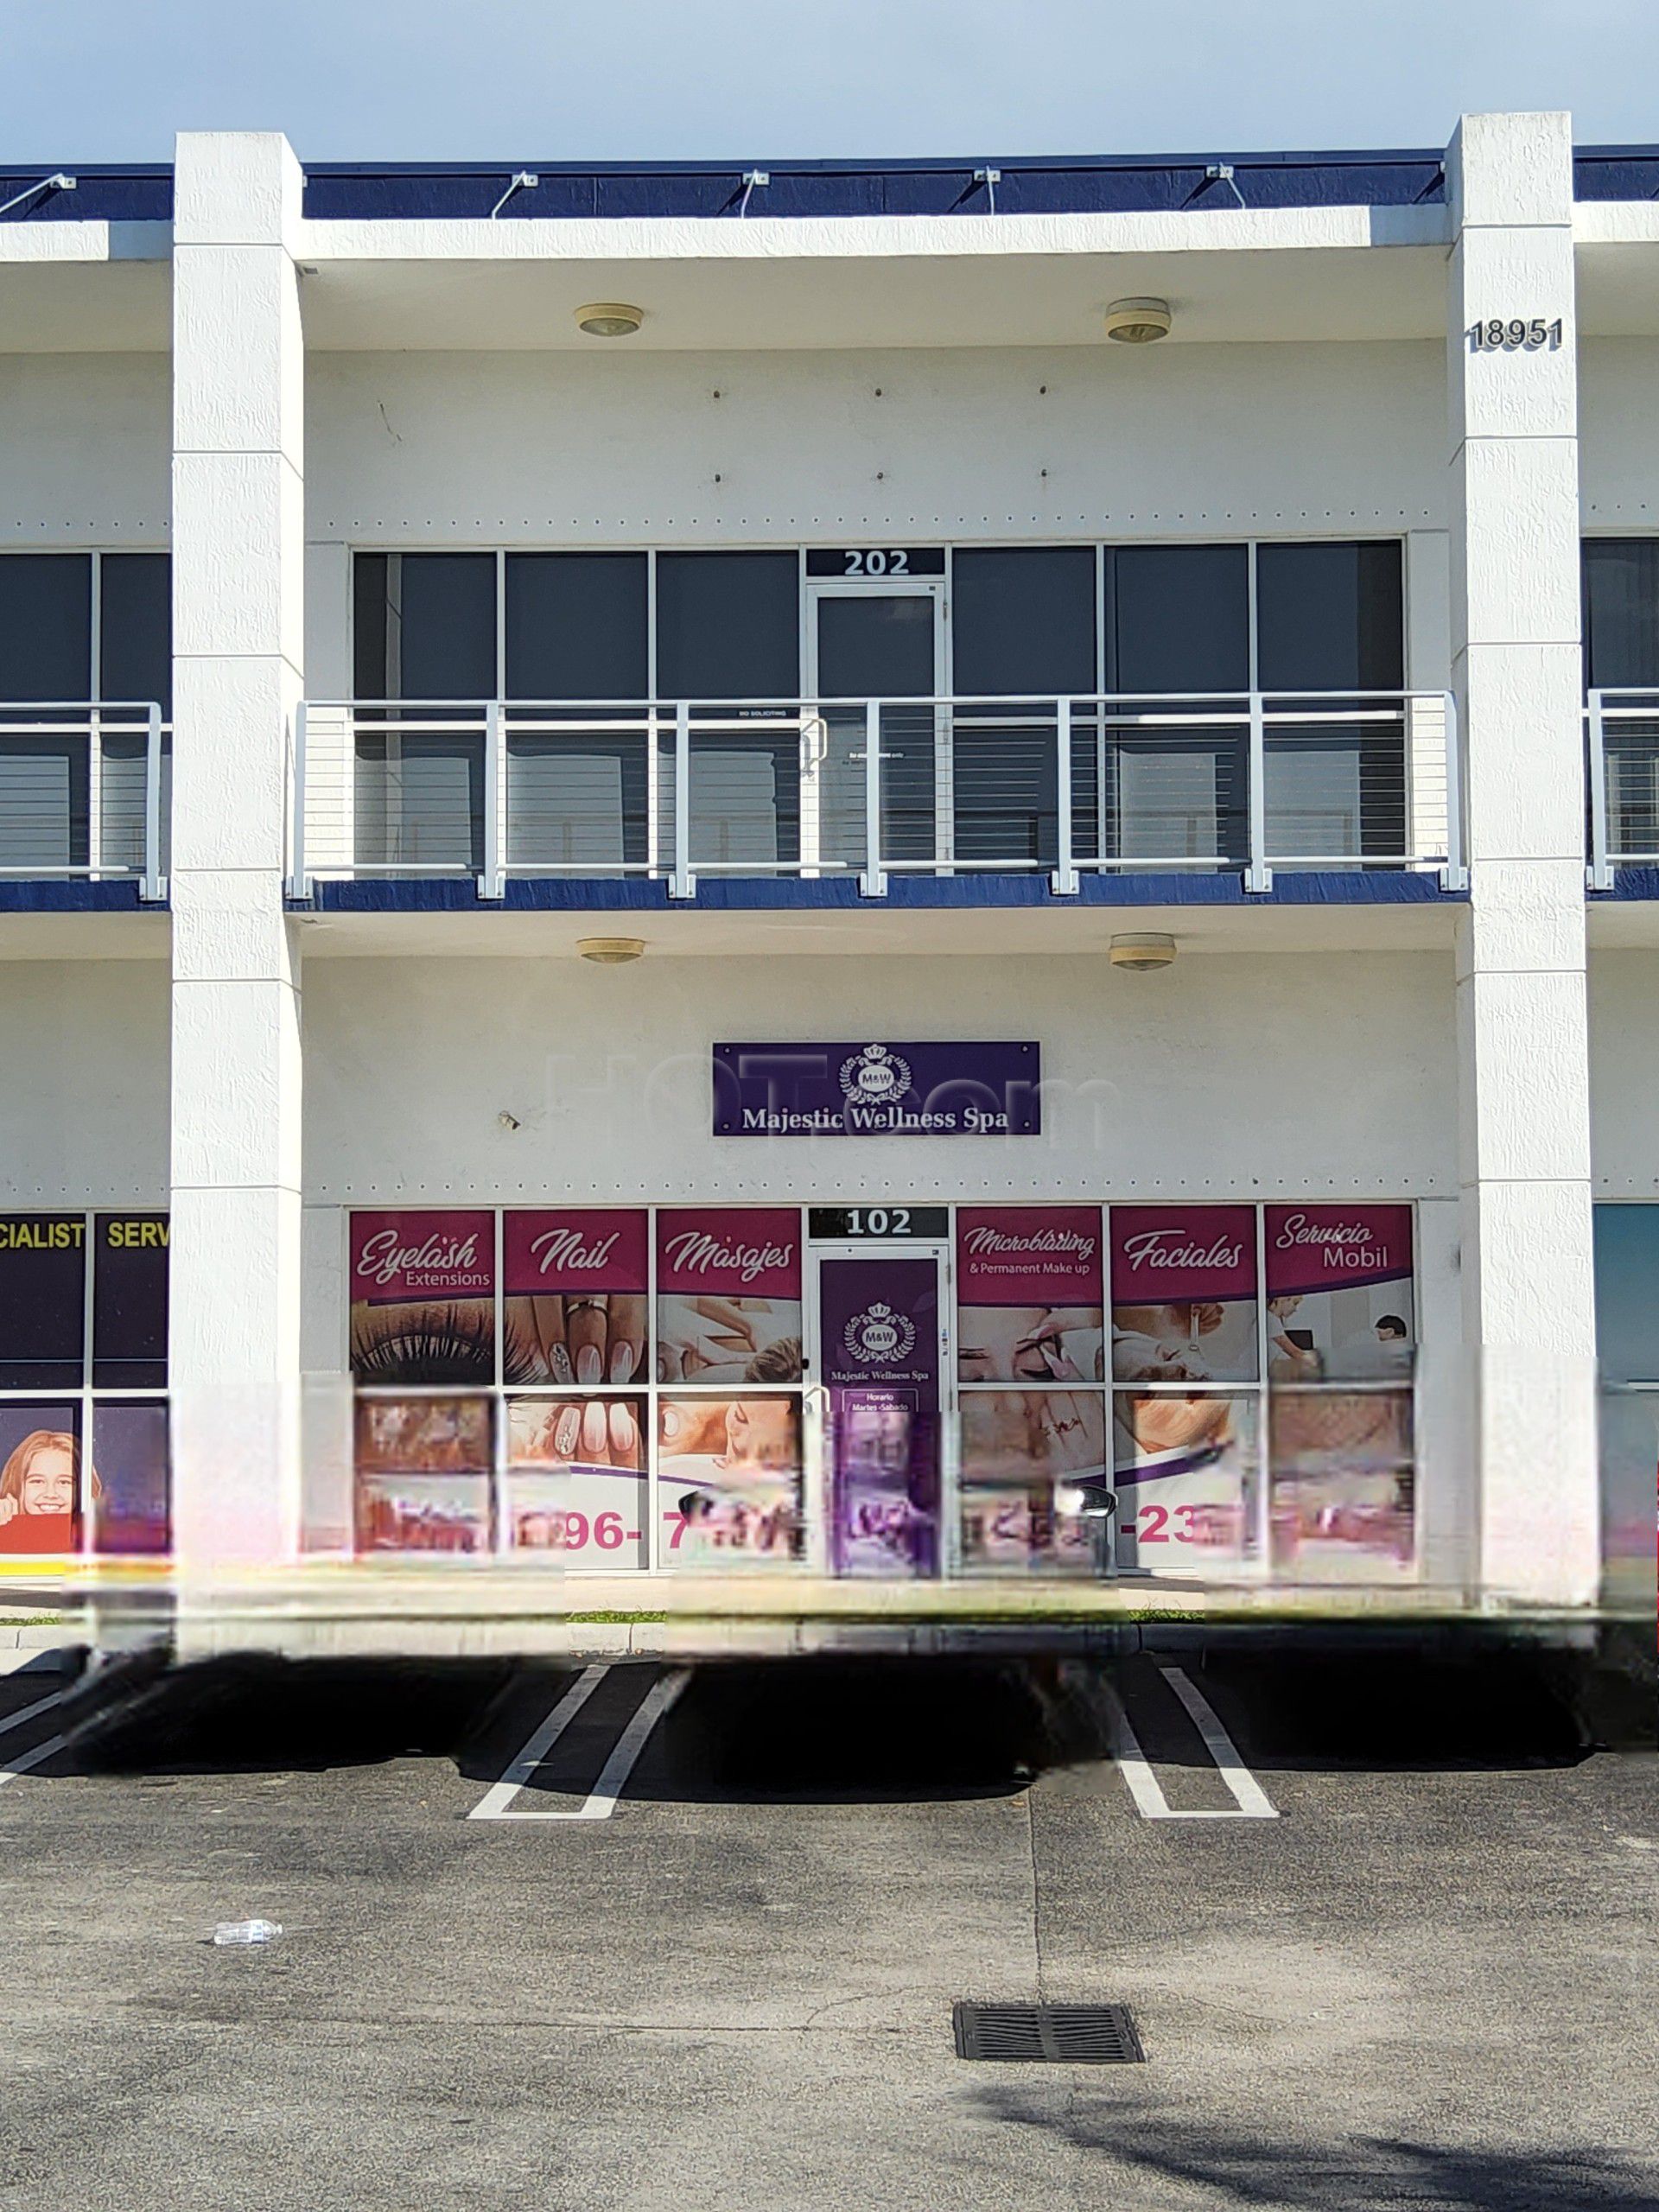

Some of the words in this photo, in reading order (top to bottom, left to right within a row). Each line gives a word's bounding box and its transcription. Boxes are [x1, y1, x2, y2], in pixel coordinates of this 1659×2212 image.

[1469, 318, 1562, 347] 18951
[844, 550, 910, 575] 202
[861, 1072, 892, 1084] M&W
[741, 1107, 843, 1133] Majestic
[850, 1106, 957, 1128] Wellness
[963, 1107, 1009, 1134] Spa
[847, 1209, 912, 1235] 102
[1275, 1213, 1374, 1249] Servicio
[531, 1228, 621, 1274] Nail
[664, 1230, 794, 1282] Masajes
[963, 1226, 1096, 1261] Microblading
[1123, 1229, 1244, 1272] Faciales
[1323, 1245, 1389, 1268] Mobil
[357, 1229, 479, 1286] Eyelash
[969, 1264, 979, 1274] &
[981, 1262, 1039, 1274] Permanent
[1042, 1262, 1073, 1274] Make
[1077, 1265, 1090, 1277] up
[405, 1270, 491, 1287] Extensions
[865, 1332, 893, 1343] M&W
[831, 1370, 869, 1382] Majestic
[871, 1370, 911, 1380] Wellness
[912, 1370, 929, 1382] Spa
